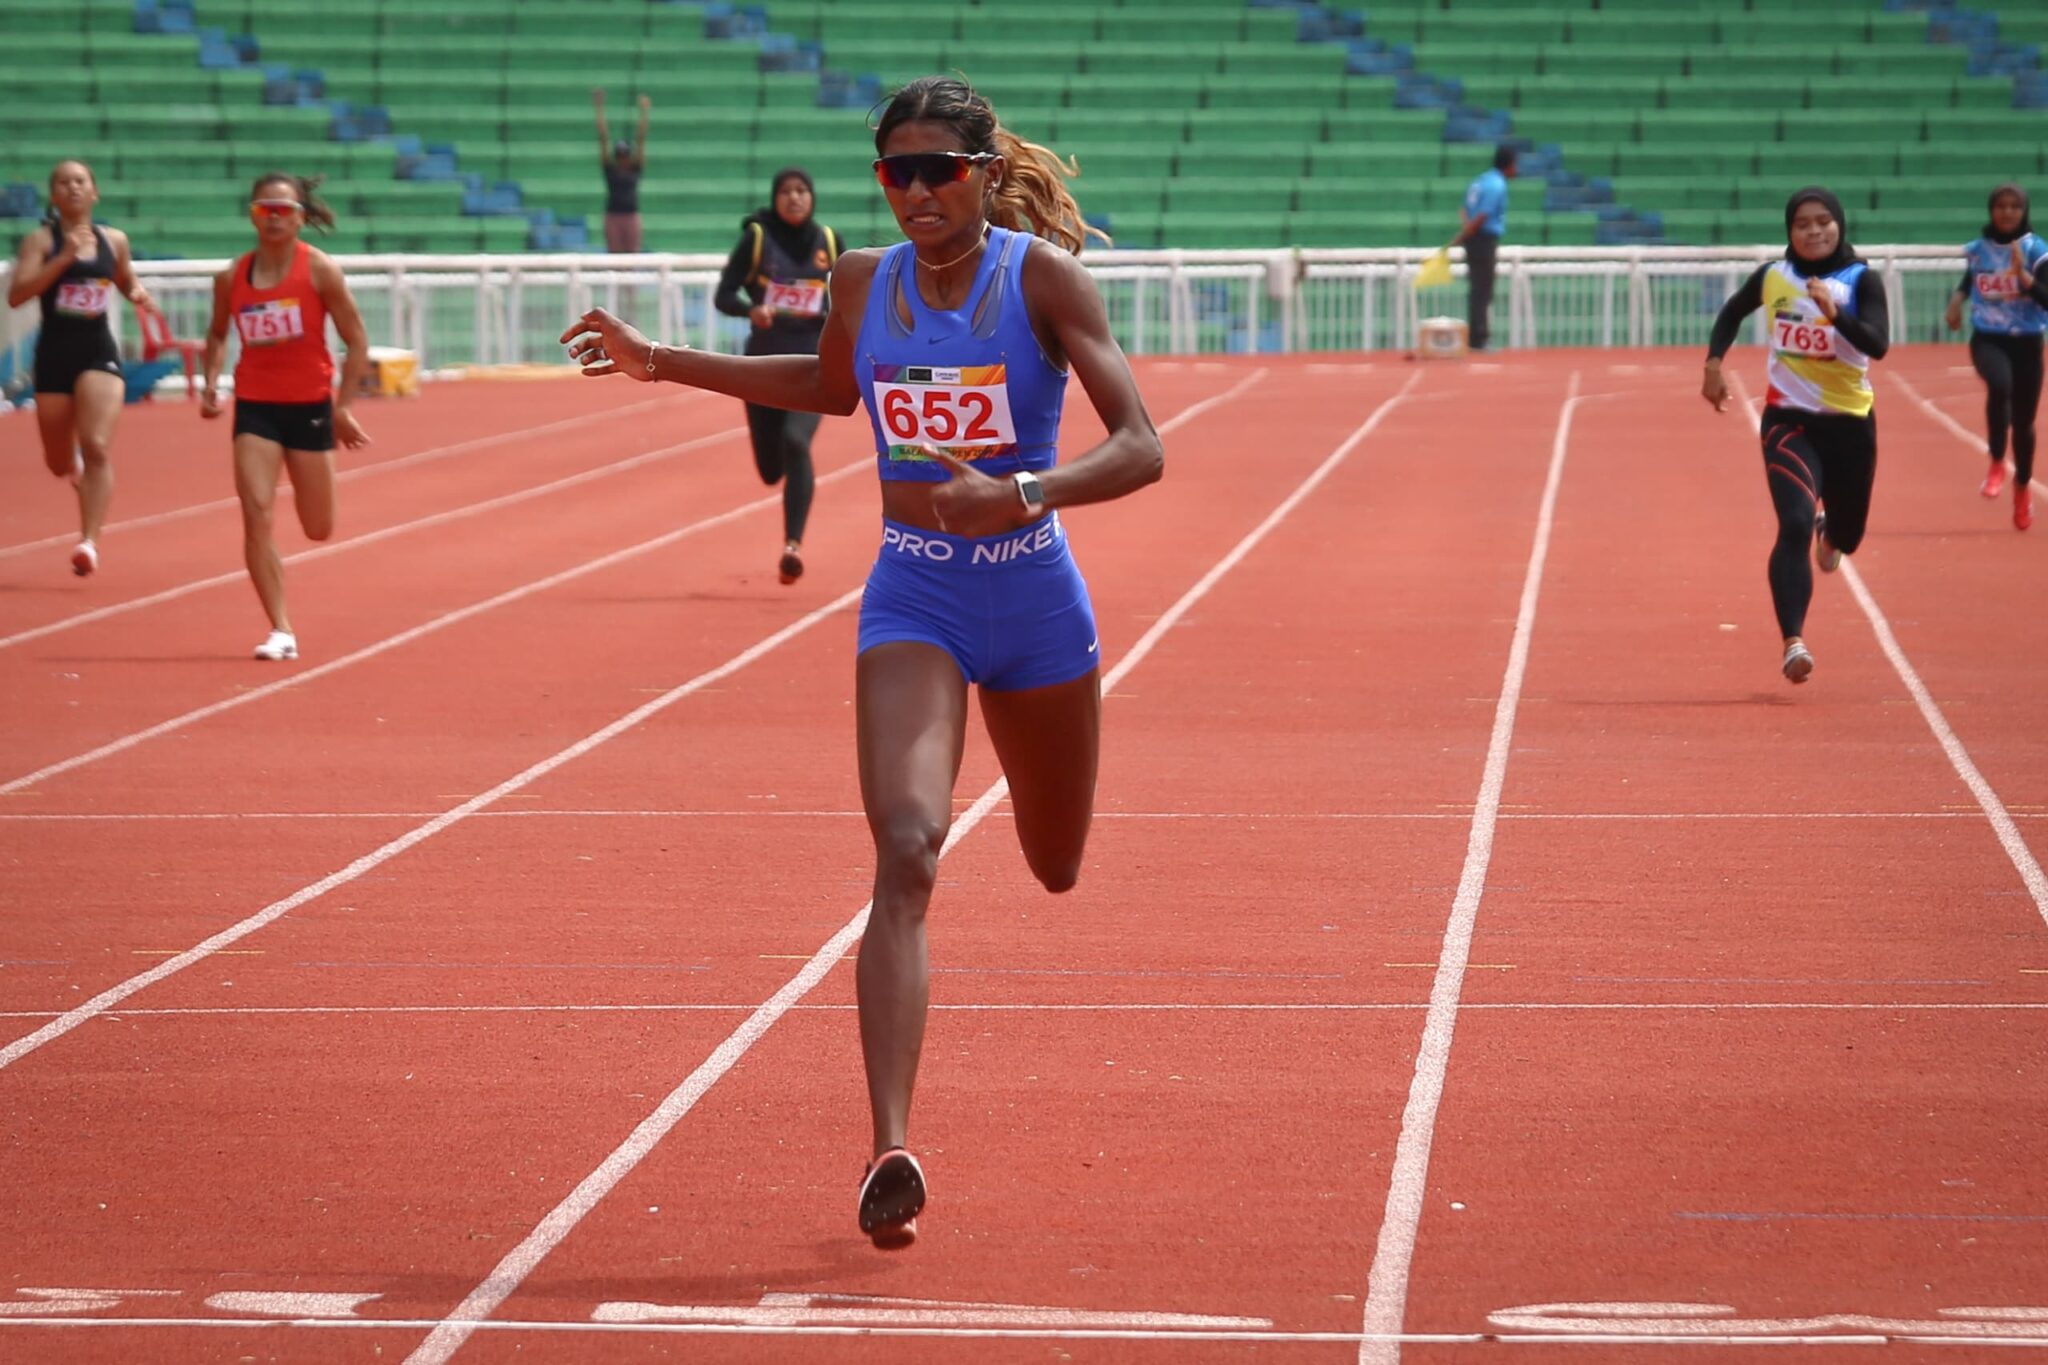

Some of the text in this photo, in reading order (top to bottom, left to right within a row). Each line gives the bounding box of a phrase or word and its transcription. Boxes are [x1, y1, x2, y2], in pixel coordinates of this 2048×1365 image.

[772, 286, 816, 307] 757
[245, 310, 292, 338] 751
[1778, 322, 1829, 351] 763
[884, 389, 999, 441] 652
[882, 525, 953, 561] PRO
[971, 521, 1053, 565] NIKE
